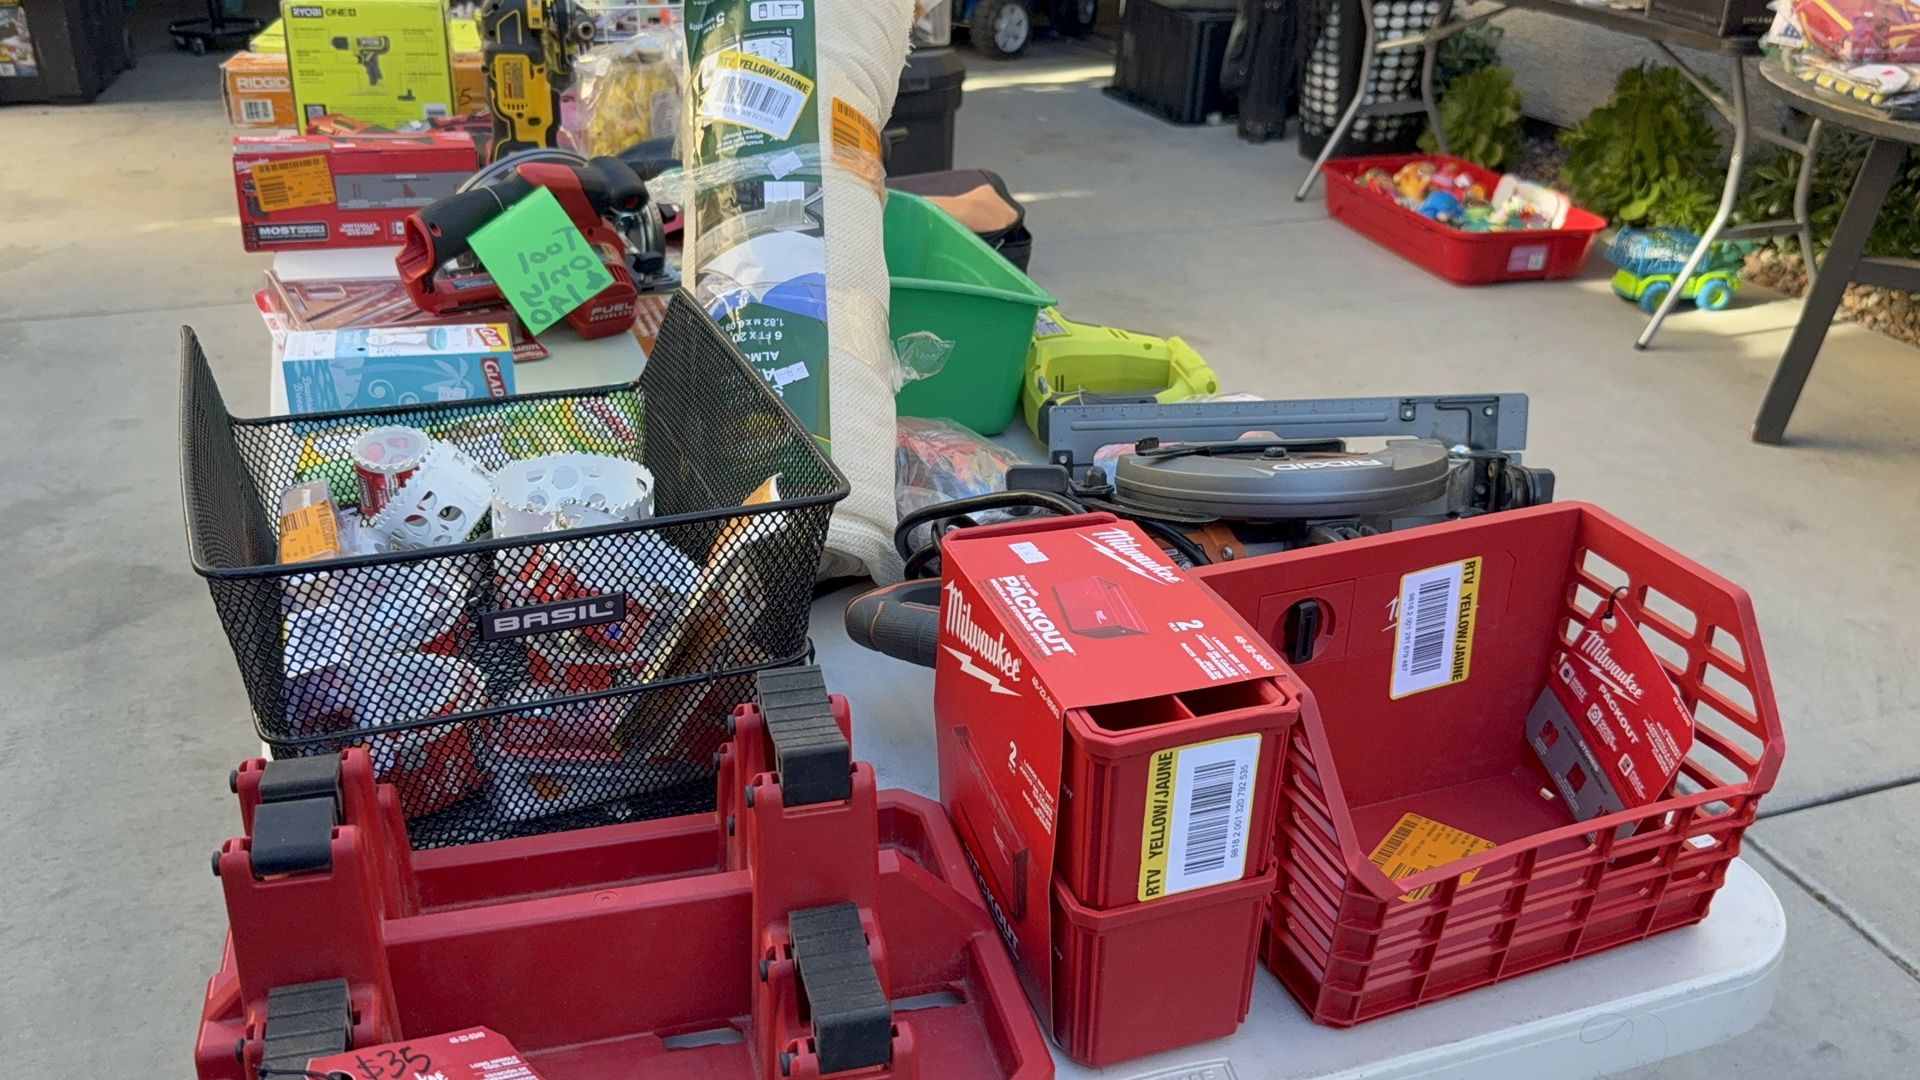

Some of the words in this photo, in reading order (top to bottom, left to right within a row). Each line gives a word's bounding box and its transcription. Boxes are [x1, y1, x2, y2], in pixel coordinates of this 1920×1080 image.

[292, 7, 322, 17] RYOBI
[716, 12, 725, 27] 5
[236, 76, 290, 89] RIDGID
[739, 58, 810, 95] YELLOW/JAUNE
[259, 226, 296, 235] MOST
[591, 303, 634, 316] FUEL
[763, 318, 784, 327] 1.82
[774, 330, 783, 340] 6
[484, 360, 505, 397] GLAD
[1272, 459, 1383, 470] RIDGID
[1091, 527, 1181, 584] Milwaukee
[1463, 560, 1476, 585] RTV
[494, 603, 614, 632] BASIL
[998, 575, 1075, 654] PACKOUT
[1175, 619, 1205, 631] 2
[944, 579, 1021, 682] Milwaukee
[1010, 605, 1035, 632] STORAGE
[1030, 631, 1053, 656] SYSTEM
[1452, 592, 1473, 682] YELLOW/JAUNE
[1237, 663, 1252, 674] SET
[1580, 630, 1644, 700] Milwaukee
[1598, 683, 1639, 744] PACKOUT
[1009, 740, 1018, 769] 2
[1579, 740, 1599, 772] STORES
[1240, 764, 1249, 781] 535
[1238, 780, 1247, 798] 792
[1148, 751, 1173, 860] YELLOW/JAUNE
[1236, 798, 1245, 816] 320
[1234, 816, 1242, 832] 001
[1145, 869, 1161, 897] RTV
[355, 1045, 432, 1080] $35
